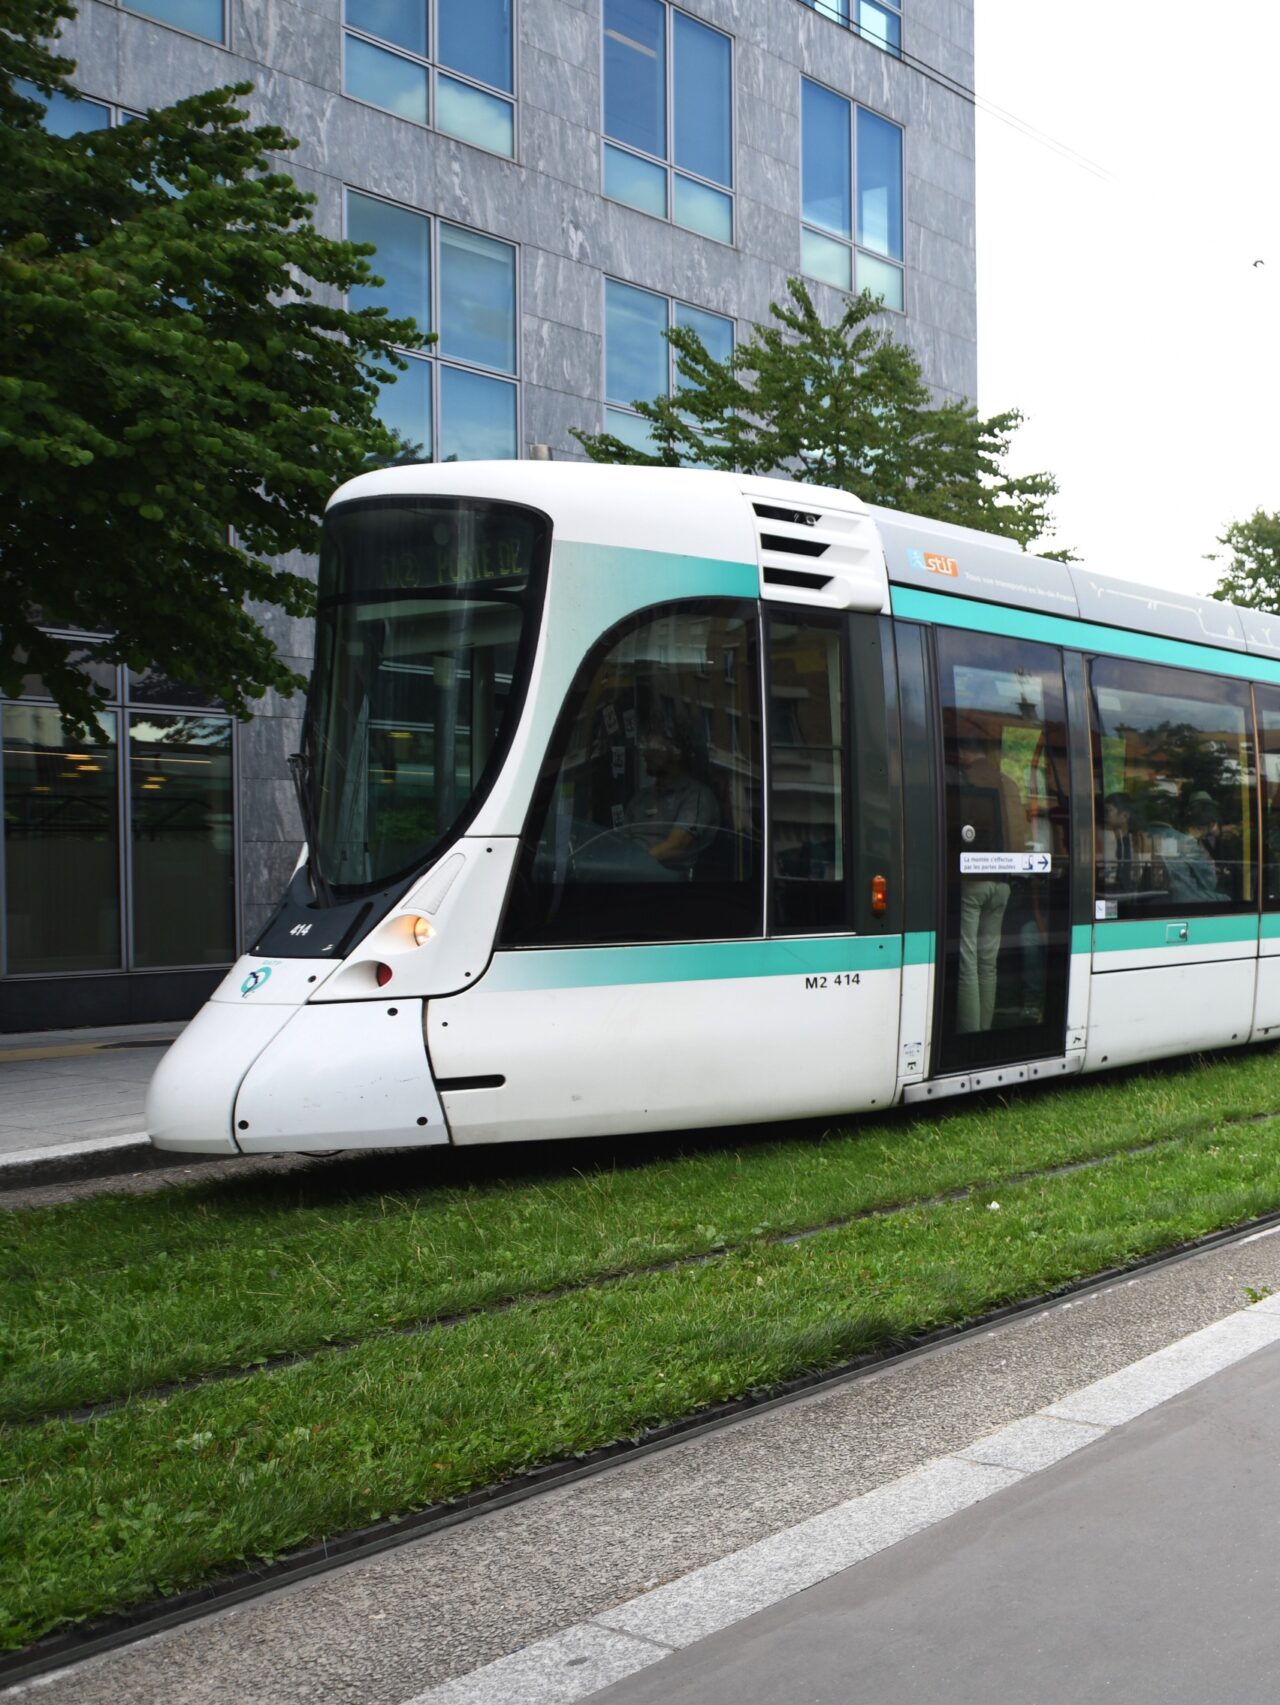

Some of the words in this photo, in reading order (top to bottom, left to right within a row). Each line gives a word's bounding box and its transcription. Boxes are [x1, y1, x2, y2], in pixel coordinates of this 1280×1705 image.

[927, 556, 955, 576] stif
[289, 923, 313, 936] 414
[805, 976, 828, 989] M2
[833, 973, 861, 986] 414
